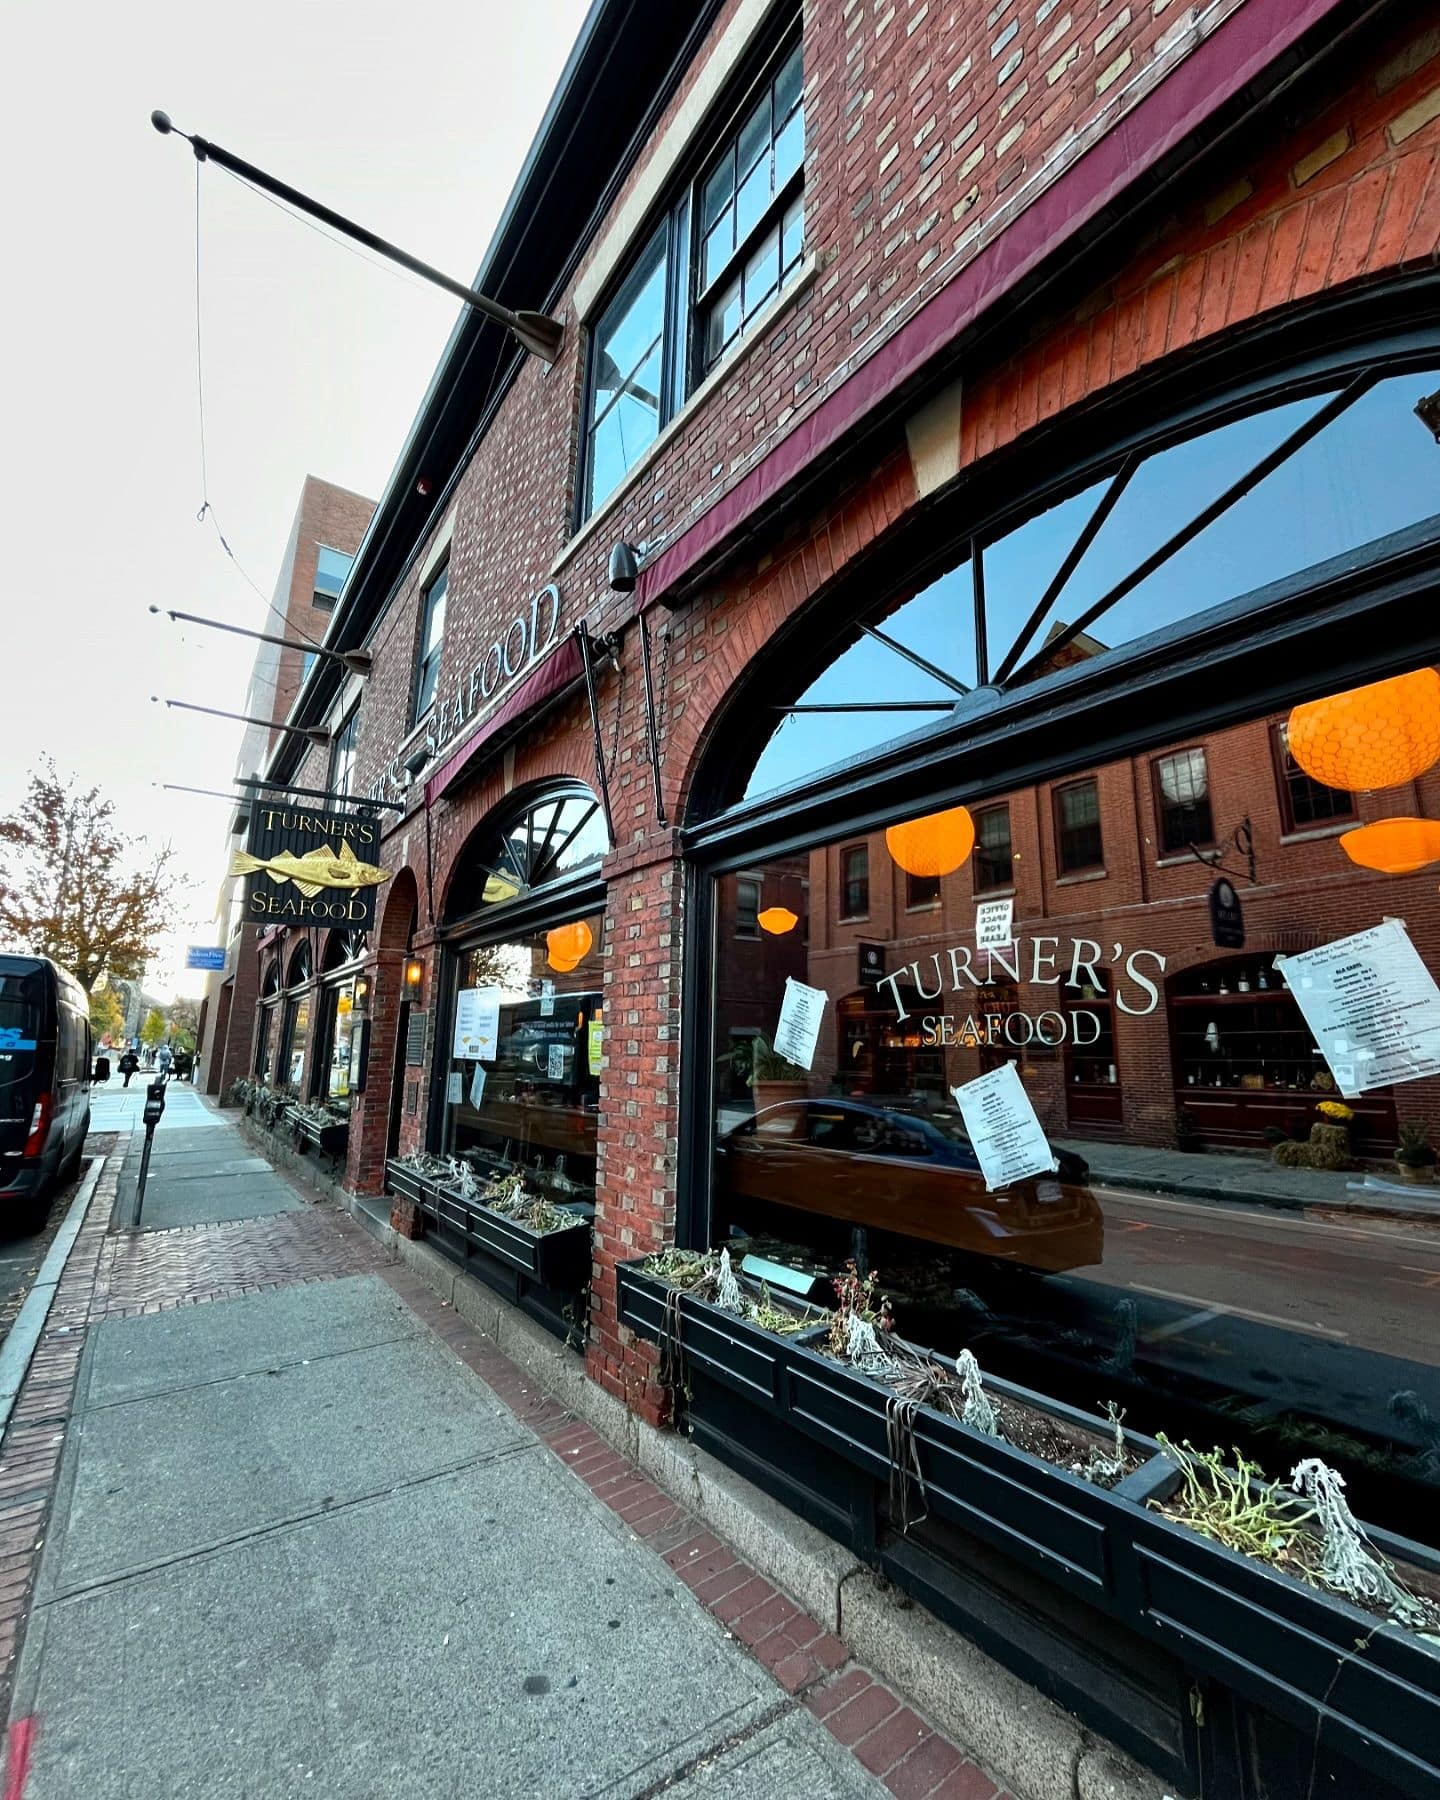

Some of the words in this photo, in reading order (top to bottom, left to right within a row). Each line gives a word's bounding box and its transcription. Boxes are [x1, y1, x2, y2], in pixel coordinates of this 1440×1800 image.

[427, 583, 559, 756] SEAFOOD
[261, 809, 373, 844] TURNER'S
[250, 891, 368, 921] SEAFOOD
[876, 937, 1167, 1024] TURNER'S
[921, 1009, 1101, 1046] SEAFOOD
